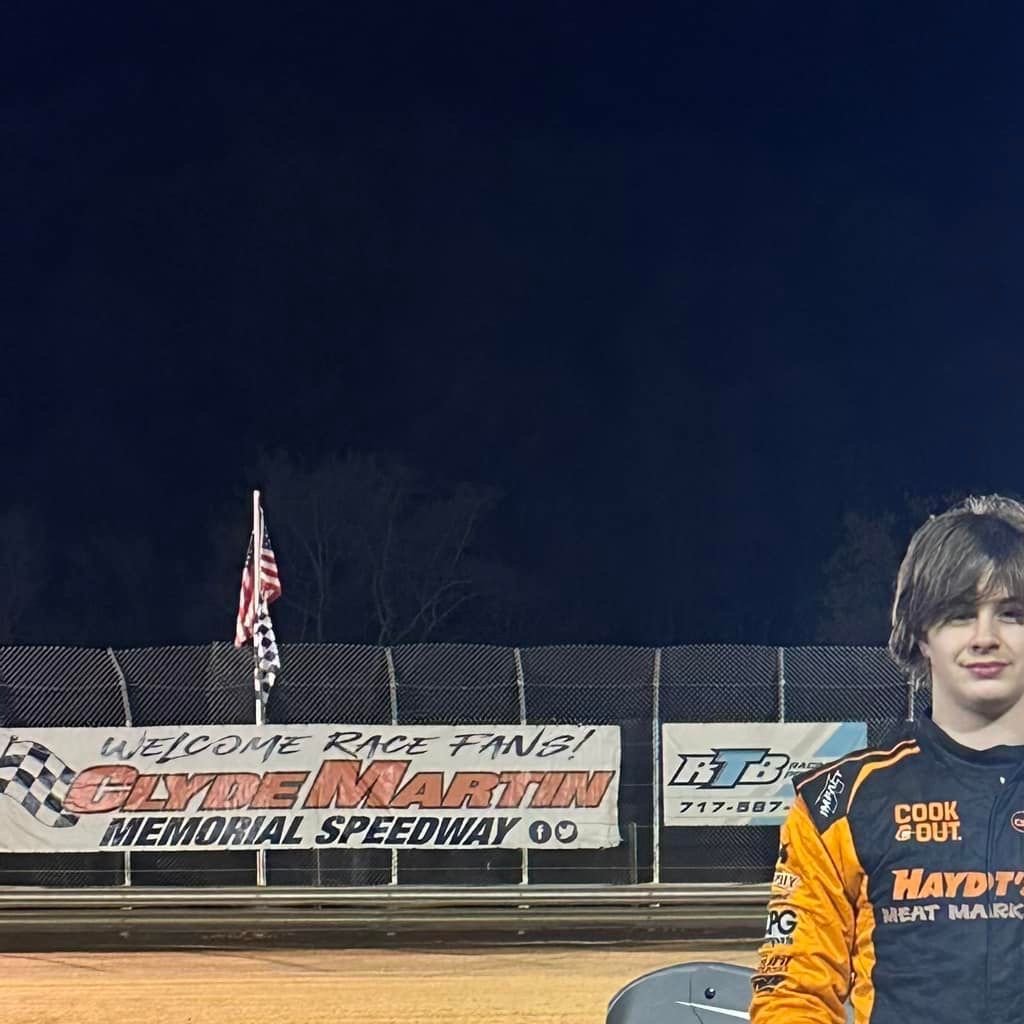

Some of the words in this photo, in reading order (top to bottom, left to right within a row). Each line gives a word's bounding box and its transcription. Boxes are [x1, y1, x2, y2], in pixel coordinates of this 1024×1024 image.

[100, 730, 312, 764] WELCOME
[323, 731, 440, 759] RACE
[449, 727, 596, 760] FANS!
[62, 765, 312, 814] CLYDE
[302, 758, 616, 810] MARTIN
[668, 748, 790, 790] RTB
[894, 800, 959, 824] COOK
[99, 815, 304, 847] MEMORIAL
[315, 815, 522, 847] SPEEDWAY
[881, 903, 940, 924] MEAT
